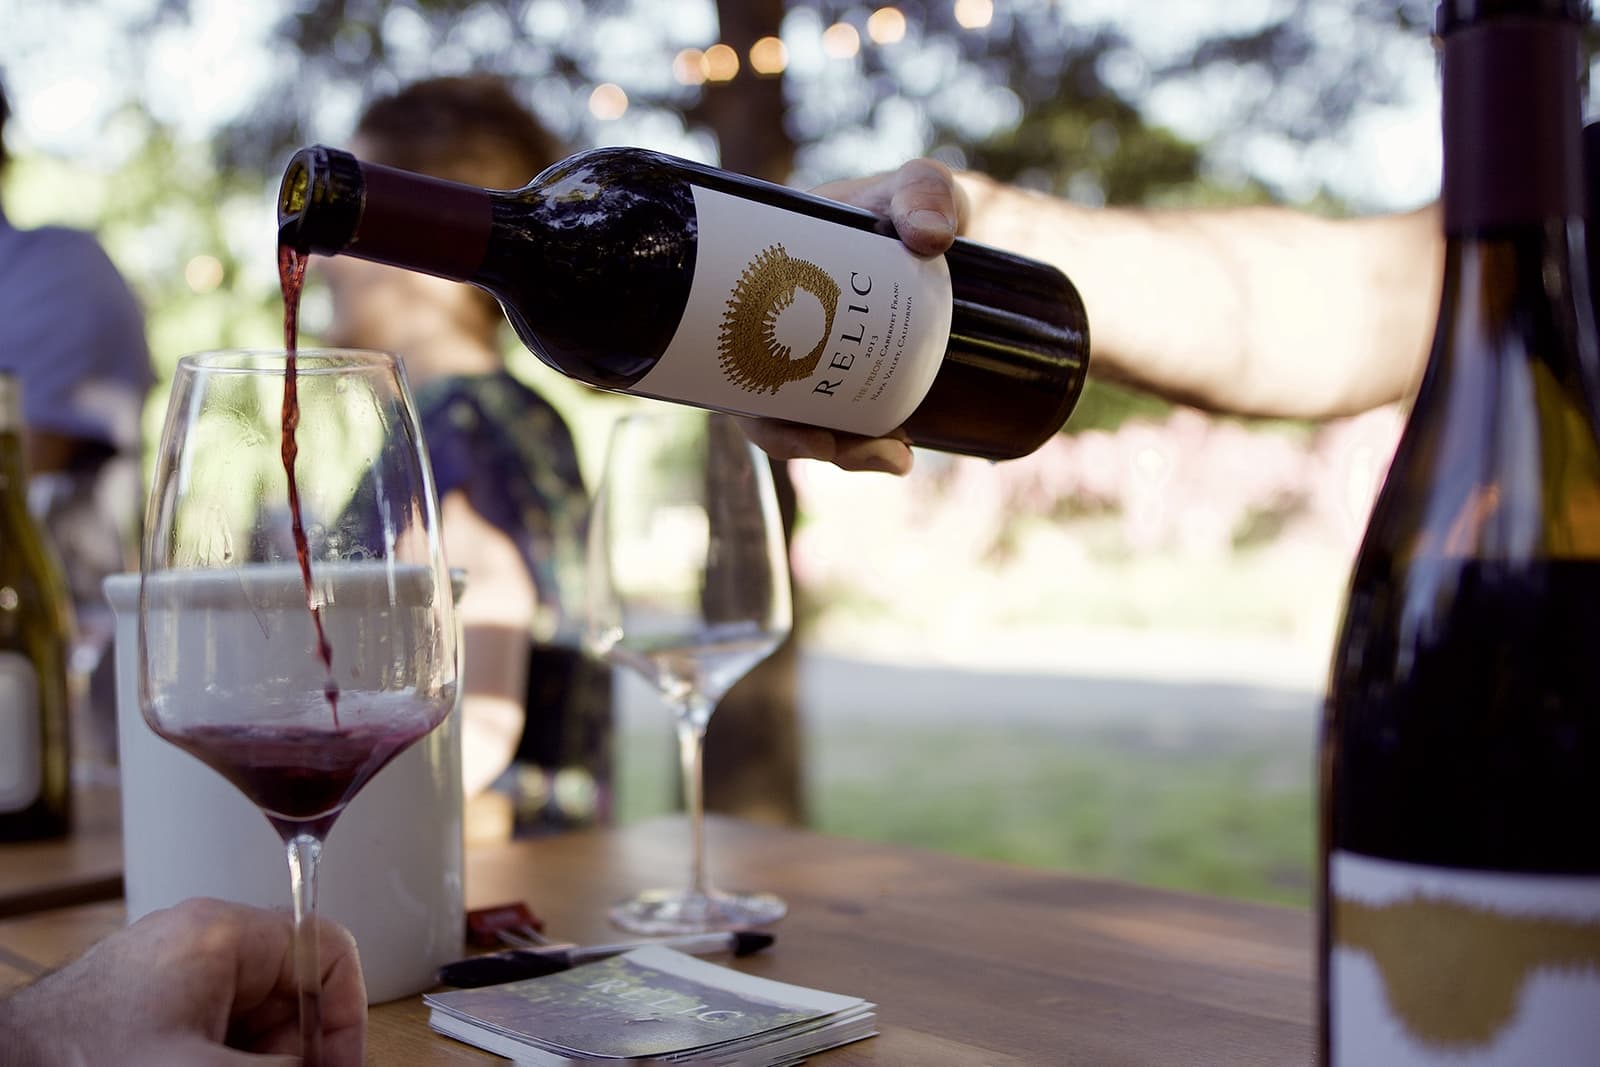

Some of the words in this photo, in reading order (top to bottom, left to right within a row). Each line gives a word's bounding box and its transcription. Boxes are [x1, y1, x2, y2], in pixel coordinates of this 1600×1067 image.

[813, 272, 872, 397] RELIC
[865, 359, 884, 387] PRIOR
[880, 313, 897, 357] CABERNET
[891, 282, 900, 311] FRANC
[866, 335, 879, 358] 2013
[897, 296, 912, 348] CALIFORNIA
[587, 978, 745, 1024] RELIC
